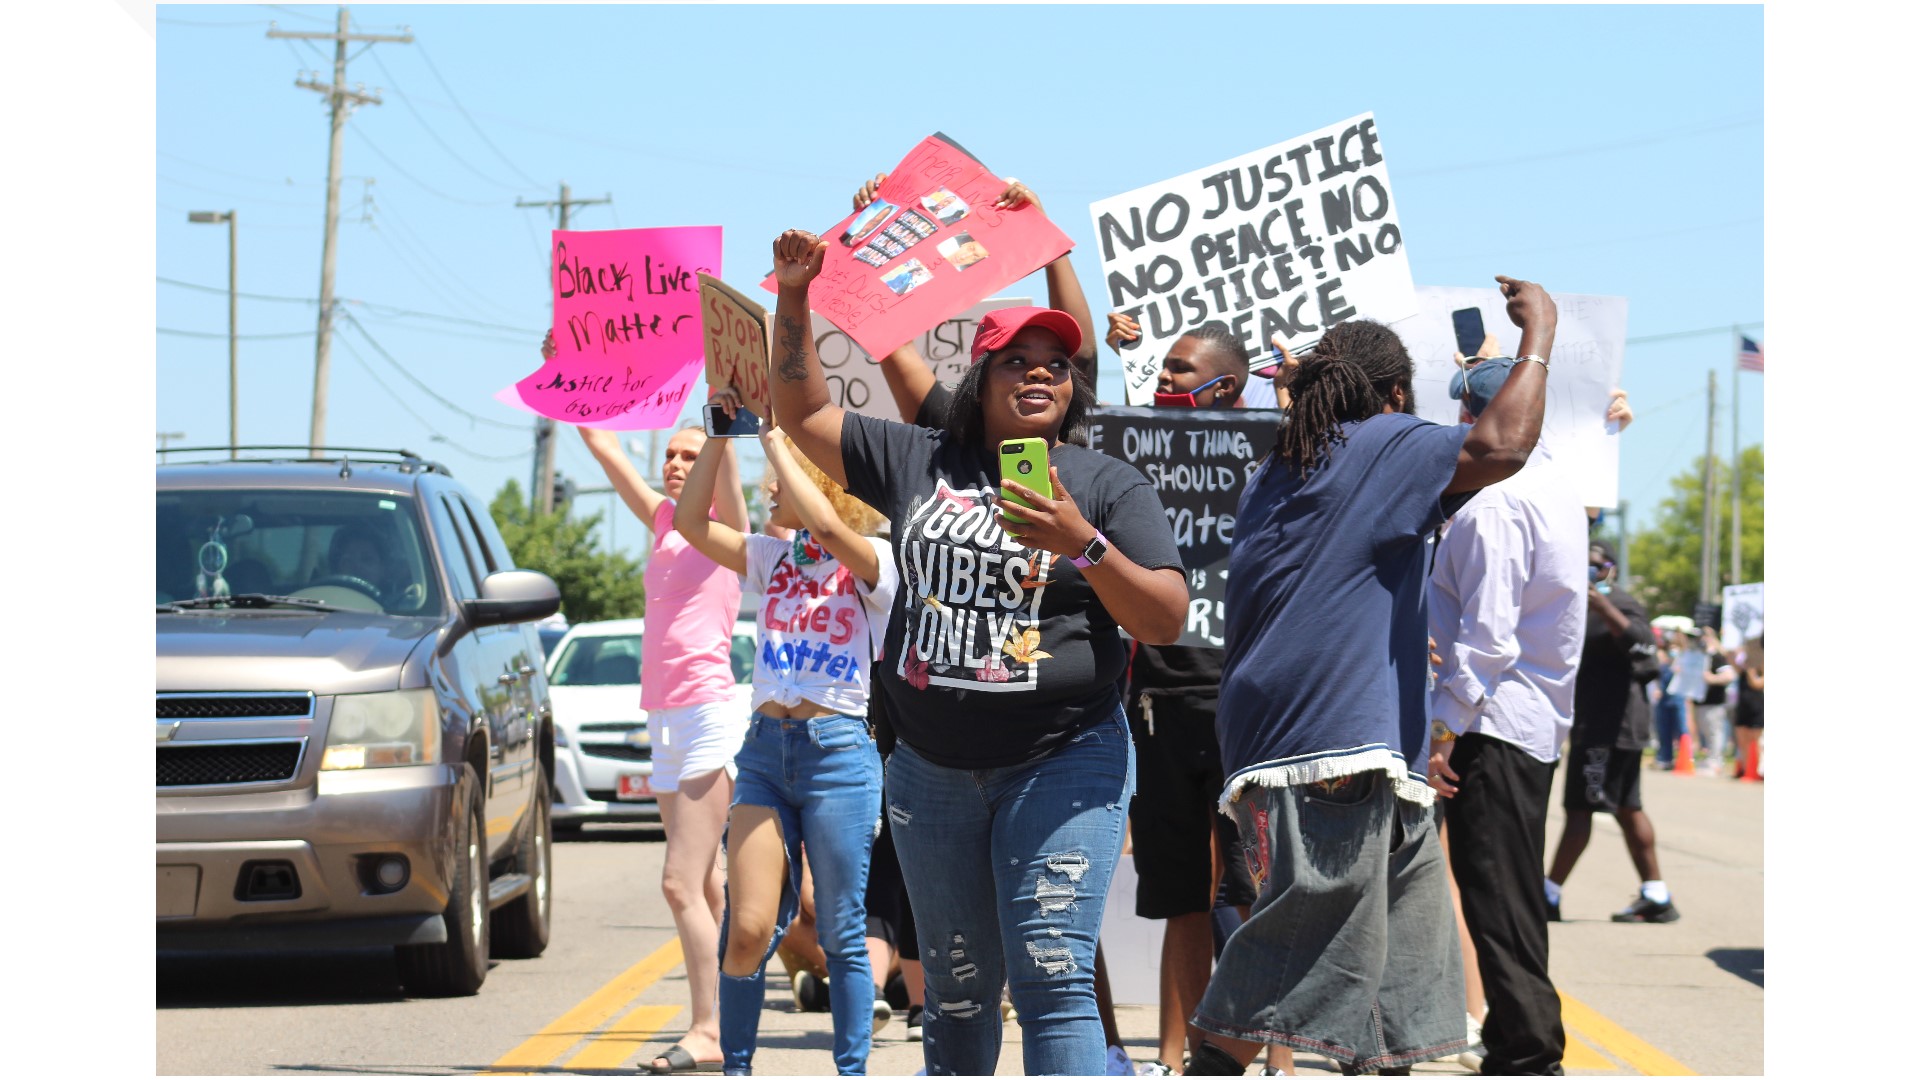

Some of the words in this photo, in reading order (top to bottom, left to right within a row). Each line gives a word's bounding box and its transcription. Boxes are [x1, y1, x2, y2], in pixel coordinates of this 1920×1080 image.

[1098, 192, 1190, 262] NO
[1202, 118, 1383, 220] JUSTICE
[1107, 254, 1183, 308] NO
[1321, 174, 1389, 236] NO
[1334, 223, 1402, 272] NO
[557, 240, 634, 302] Black
[568, 310, 694, 354] Matter
[622, 366, 653, 393] for
[1185, 428, 1254, 460] THING
[1145, 462, 1236, 493] SHOULD
[913, 540, 1030, 609] VIBES
[916, 603, 1015, 669] ONLY
